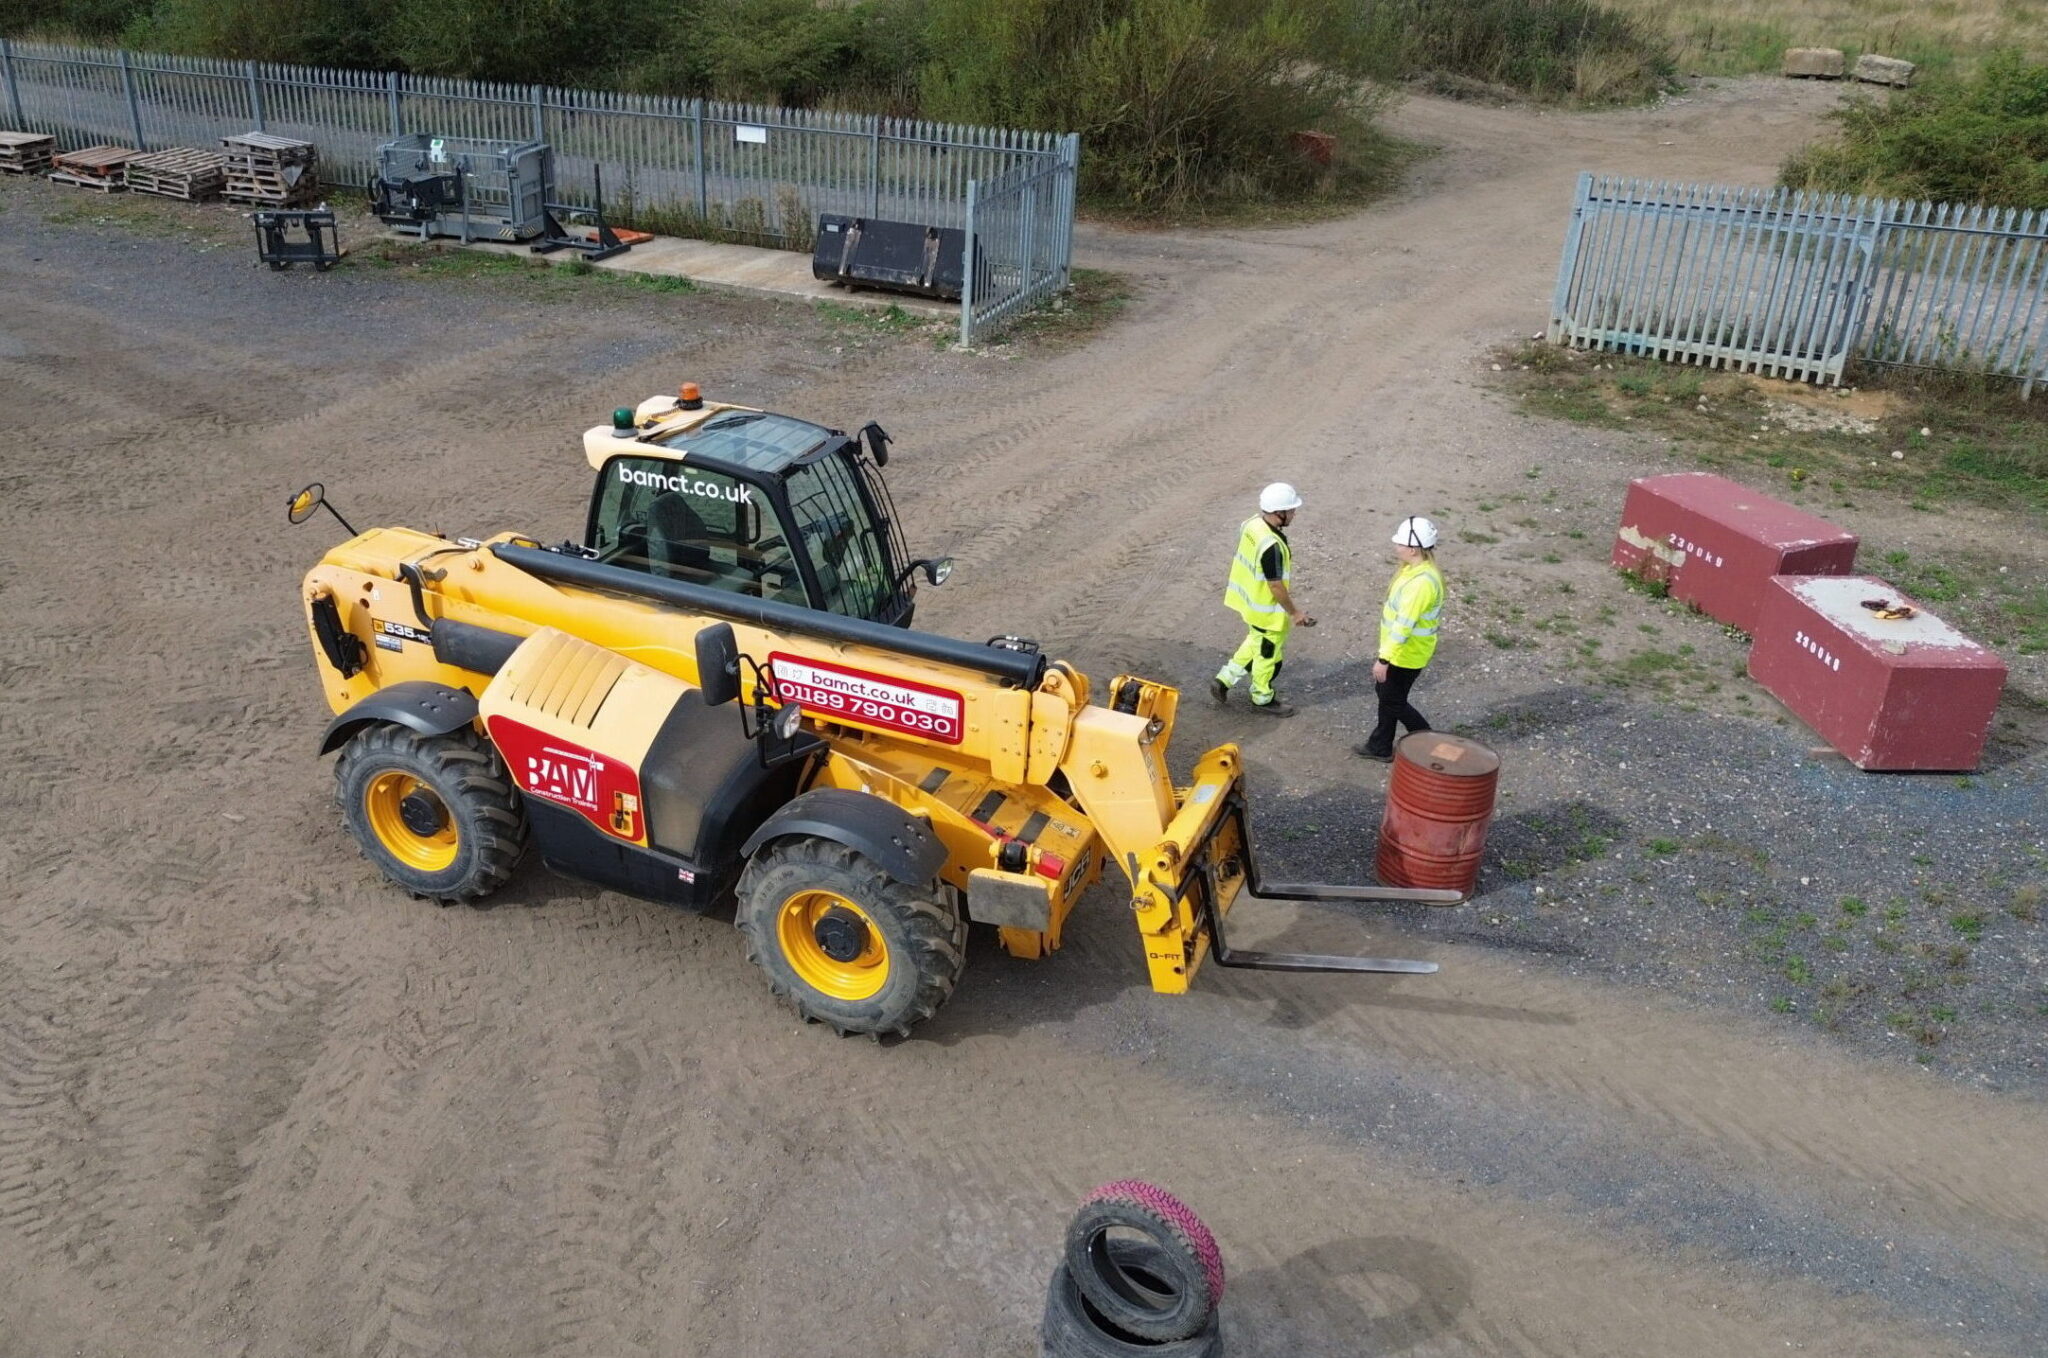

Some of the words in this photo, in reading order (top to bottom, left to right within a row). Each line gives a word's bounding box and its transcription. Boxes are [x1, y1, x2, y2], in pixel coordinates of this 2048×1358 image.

[618, 462, 753, 505] bamct.co.uk
[779, 683, 844, 709] 01189
[850, 699, 895, 721] 790
[900, 711, 951, 734] 030
[811, 671, 916, 707] bamct.co.uk
[530, 786, 571, 803] Construction
[571, 796, 598, 812] Training
